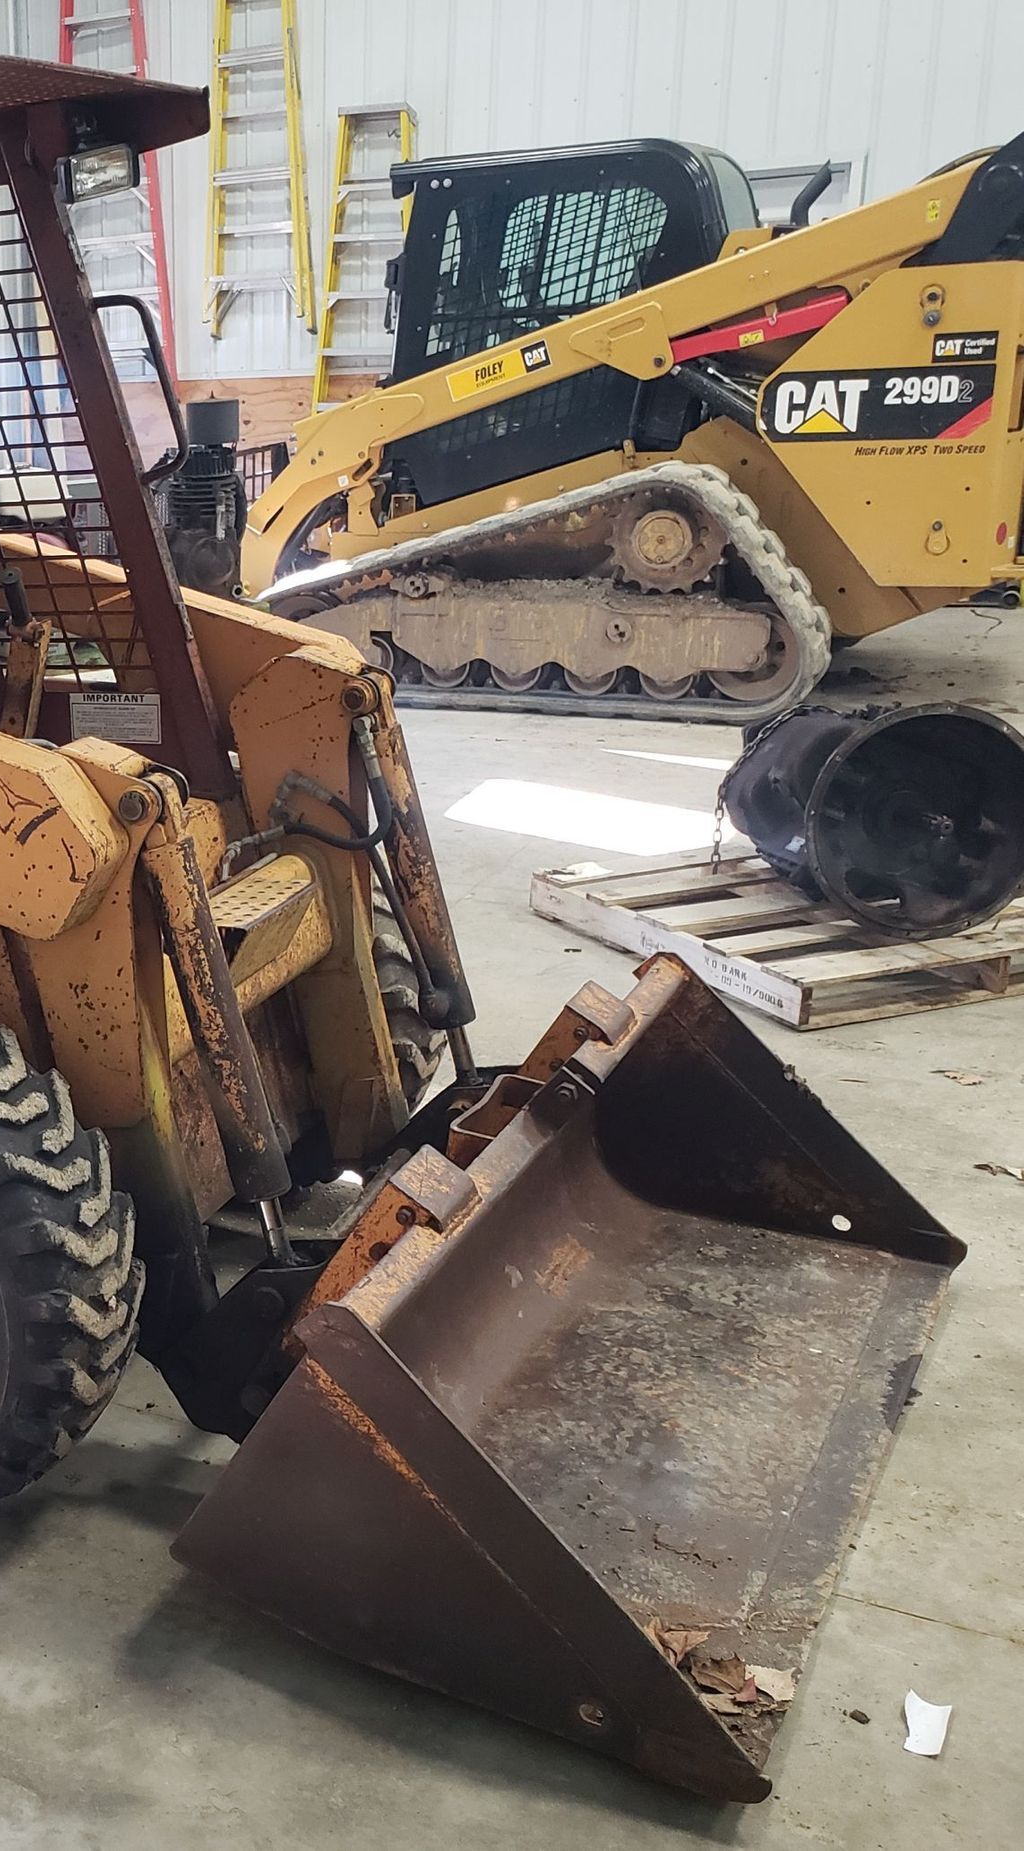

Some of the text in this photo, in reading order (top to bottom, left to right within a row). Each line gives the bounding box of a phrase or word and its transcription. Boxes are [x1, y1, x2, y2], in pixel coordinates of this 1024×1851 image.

[935, 339, 964, 356] CAT
[965, 338, 996, 346] Certified
[475, 346, 546, 382] FOLEY CAT
[774, 379, 869, 434] CAT
[906, 445, 928, 455] XPS
[82, 694, 145, 703] IMPORTANT
[721, 963, 749, 981] BARK
